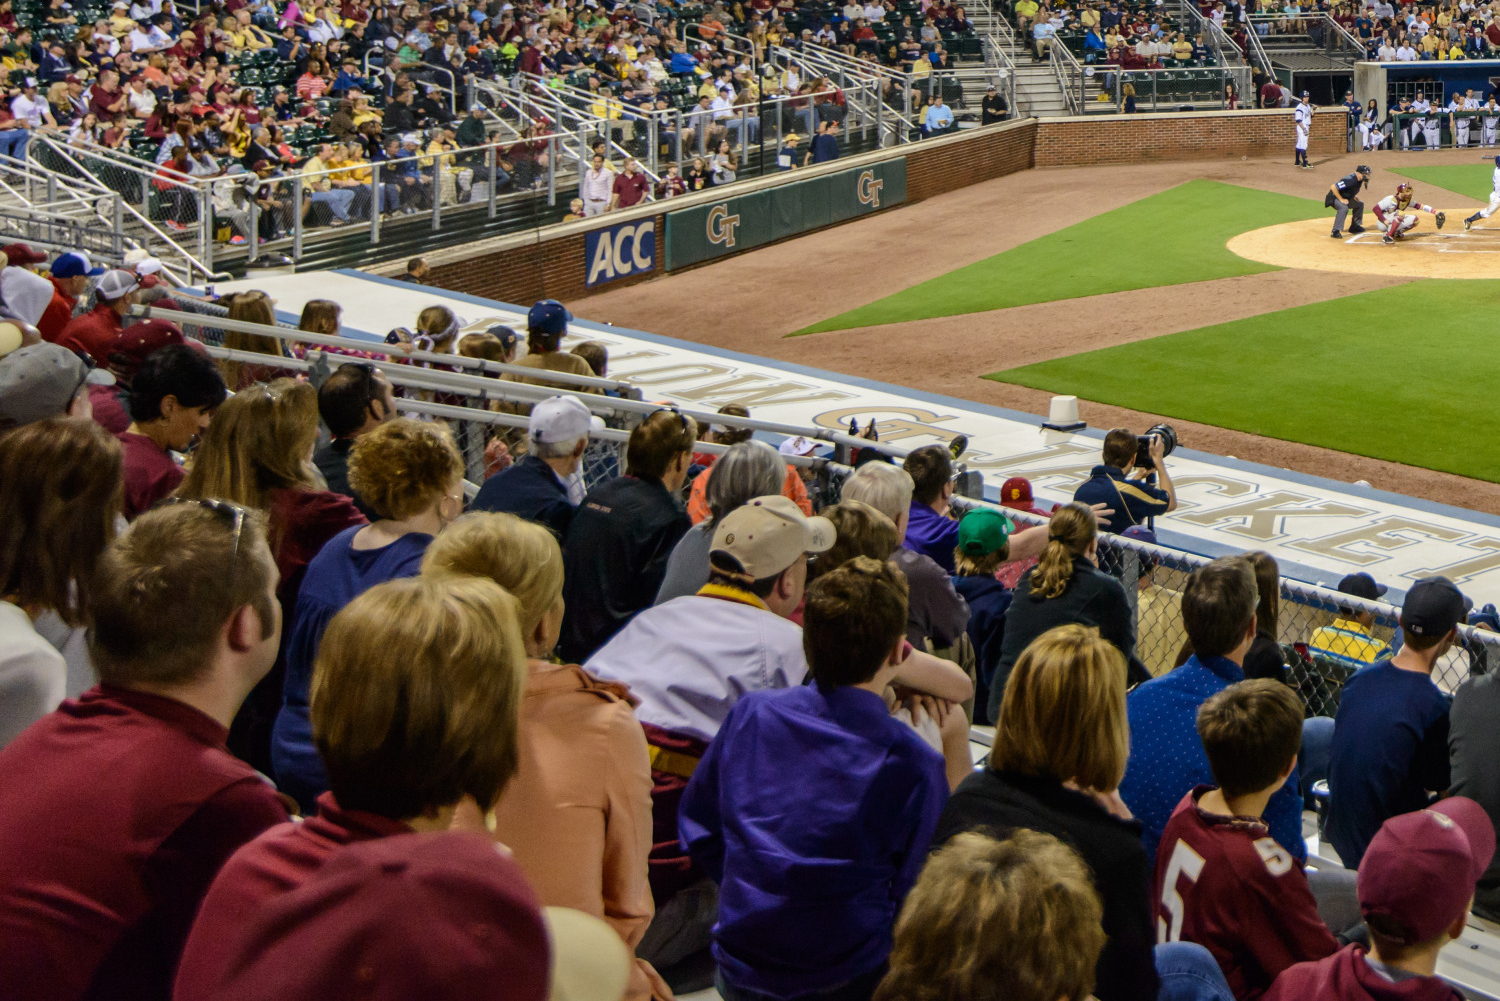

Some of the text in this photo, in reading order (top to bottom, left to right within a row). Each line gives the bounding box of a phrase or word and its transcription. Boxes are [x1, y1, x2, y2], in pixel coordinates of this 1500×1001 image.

[857, 170, 883, 207] GT
[706, 203, 740, 247] GT
[587, 221, 655, 284] ACC
[1252, 837, 1294, 878] 5
[1157, 837, 1206, 943] 5
